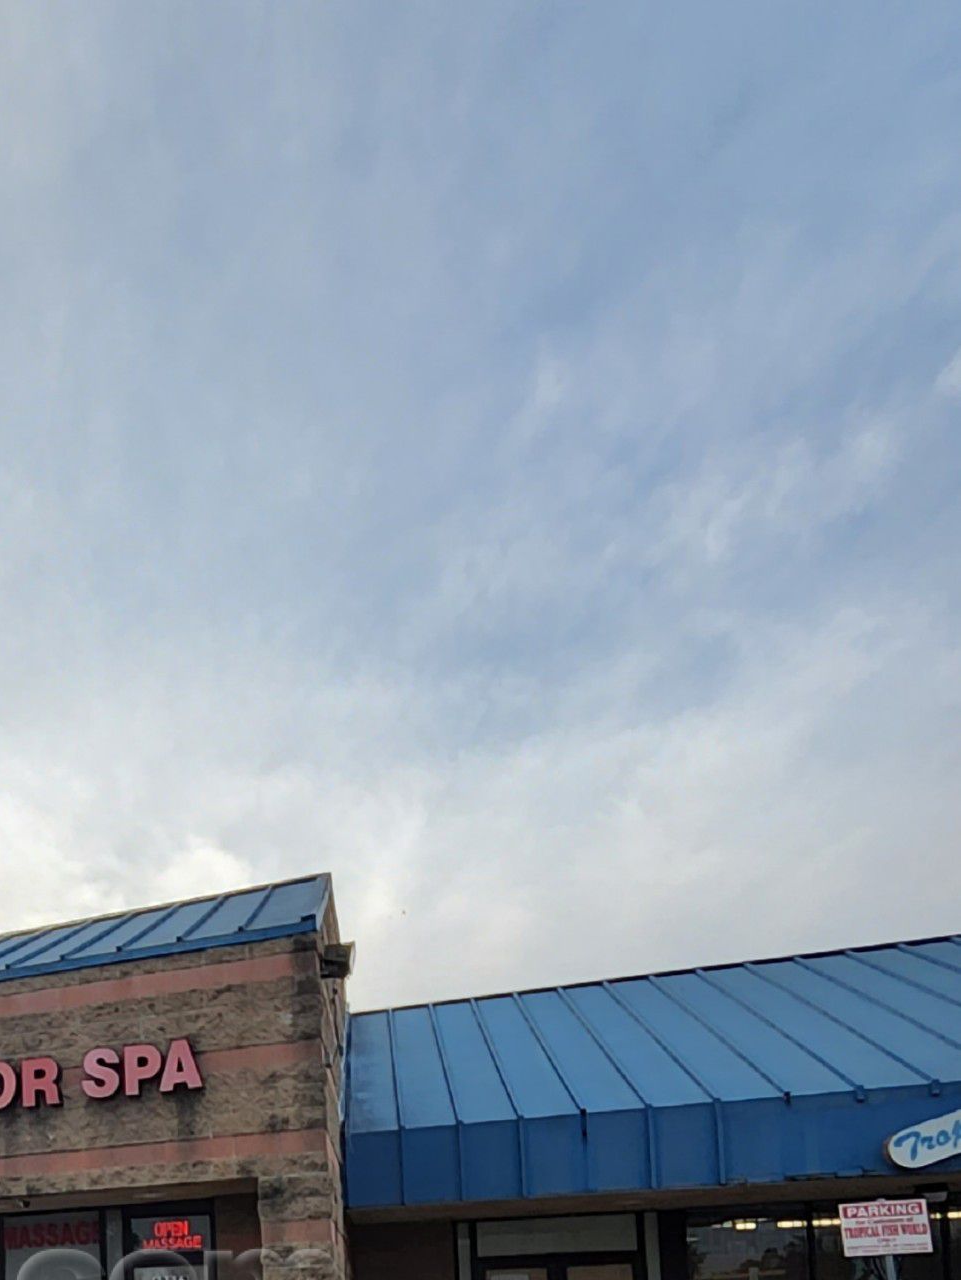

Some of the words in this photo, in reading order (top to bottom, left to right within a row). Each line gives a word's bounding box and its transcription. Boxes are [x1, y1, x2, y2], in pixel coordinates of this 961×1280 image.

[81, 1038, 203, 1099] SPA
[845, 1203, 921, 1217] PARKING
[154, 1220, 188, 1237] OPEN
[142, 1235, 203, 1249] MASSAGE
